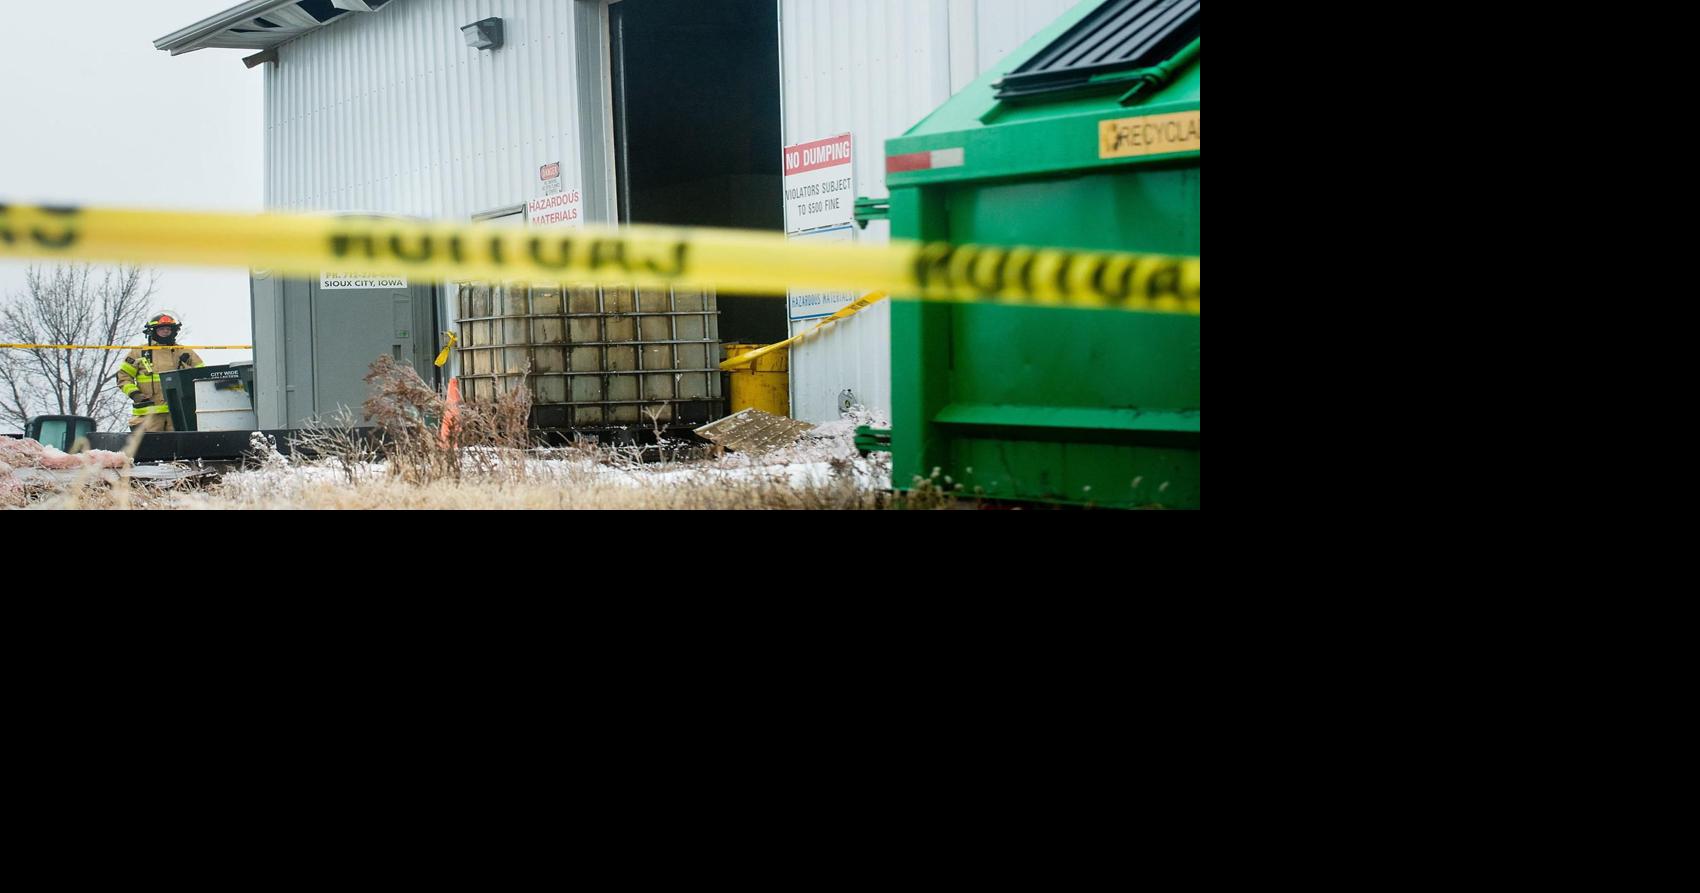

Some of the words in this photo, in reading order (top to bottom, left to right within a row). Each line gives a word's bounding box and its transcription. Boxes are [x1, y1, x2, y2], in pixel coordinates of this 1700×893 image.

[1116, 118, 1200, 148] RECYCLA
[786, 151, 800, 169] NO
[803, 141, 850, 166] DUMPING
[785, 184, 820, 200] VIOLATORS
[822, 178, 851, 194] SUBJECT
[528, 192, 579, 212] HAZARDOUS
[798, 204, 806, 216] TO
[808, 201, 822, 214] $500
[825, 198, 840, 211] FINE
[532, 208, 577, 224] MATERIALS
[354, 280, 376, 288] CITY,
[379, 279, 403, 287] IOWA
